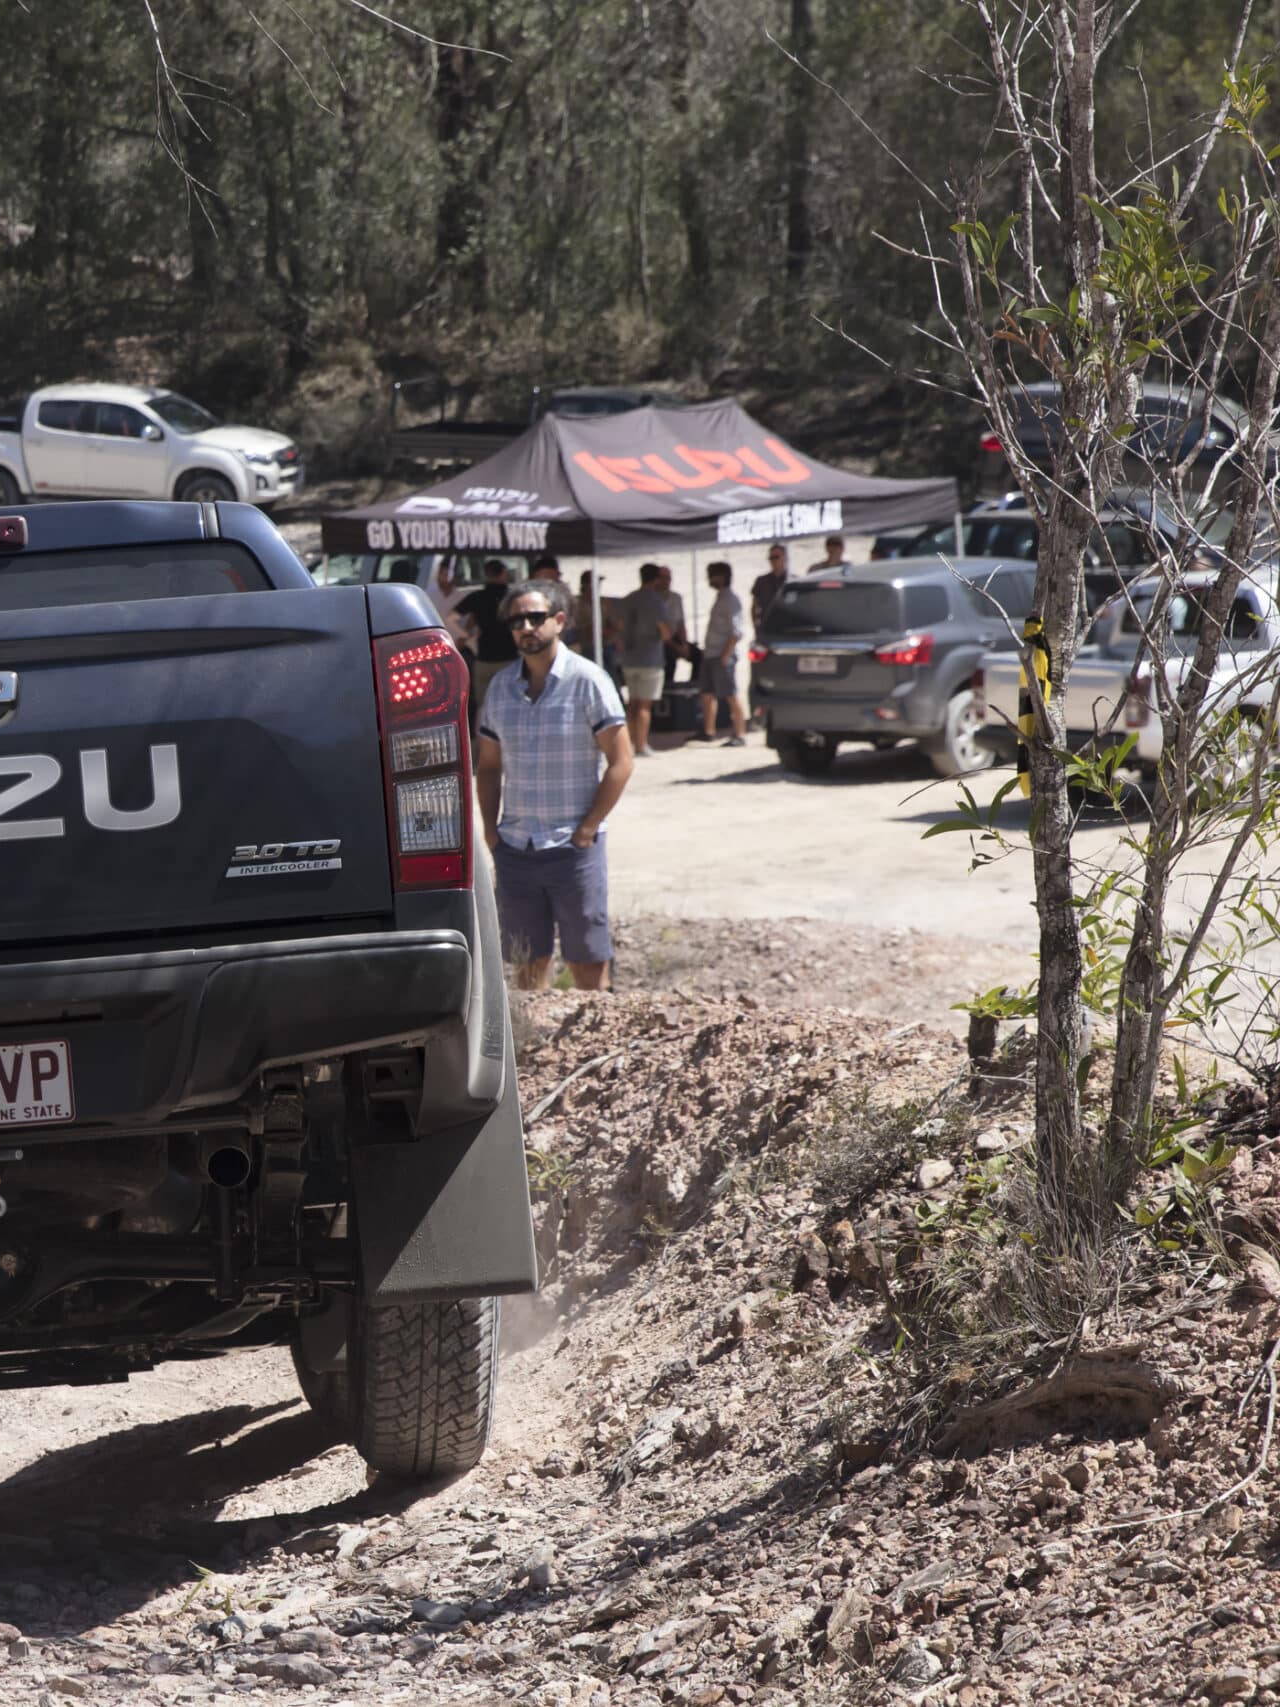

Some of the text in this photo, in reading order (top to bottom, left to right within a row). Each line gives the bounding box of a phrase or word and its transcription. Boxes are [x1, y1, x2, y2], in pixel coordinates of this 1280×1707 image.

[573, 437, 811, 493] ISUZU
[367, 519, 549, 549] GO YOUR OWN WAY
[240, 861, 329, 875] INTERCOOLER
[23, 1104, 62, 1119] STATE
